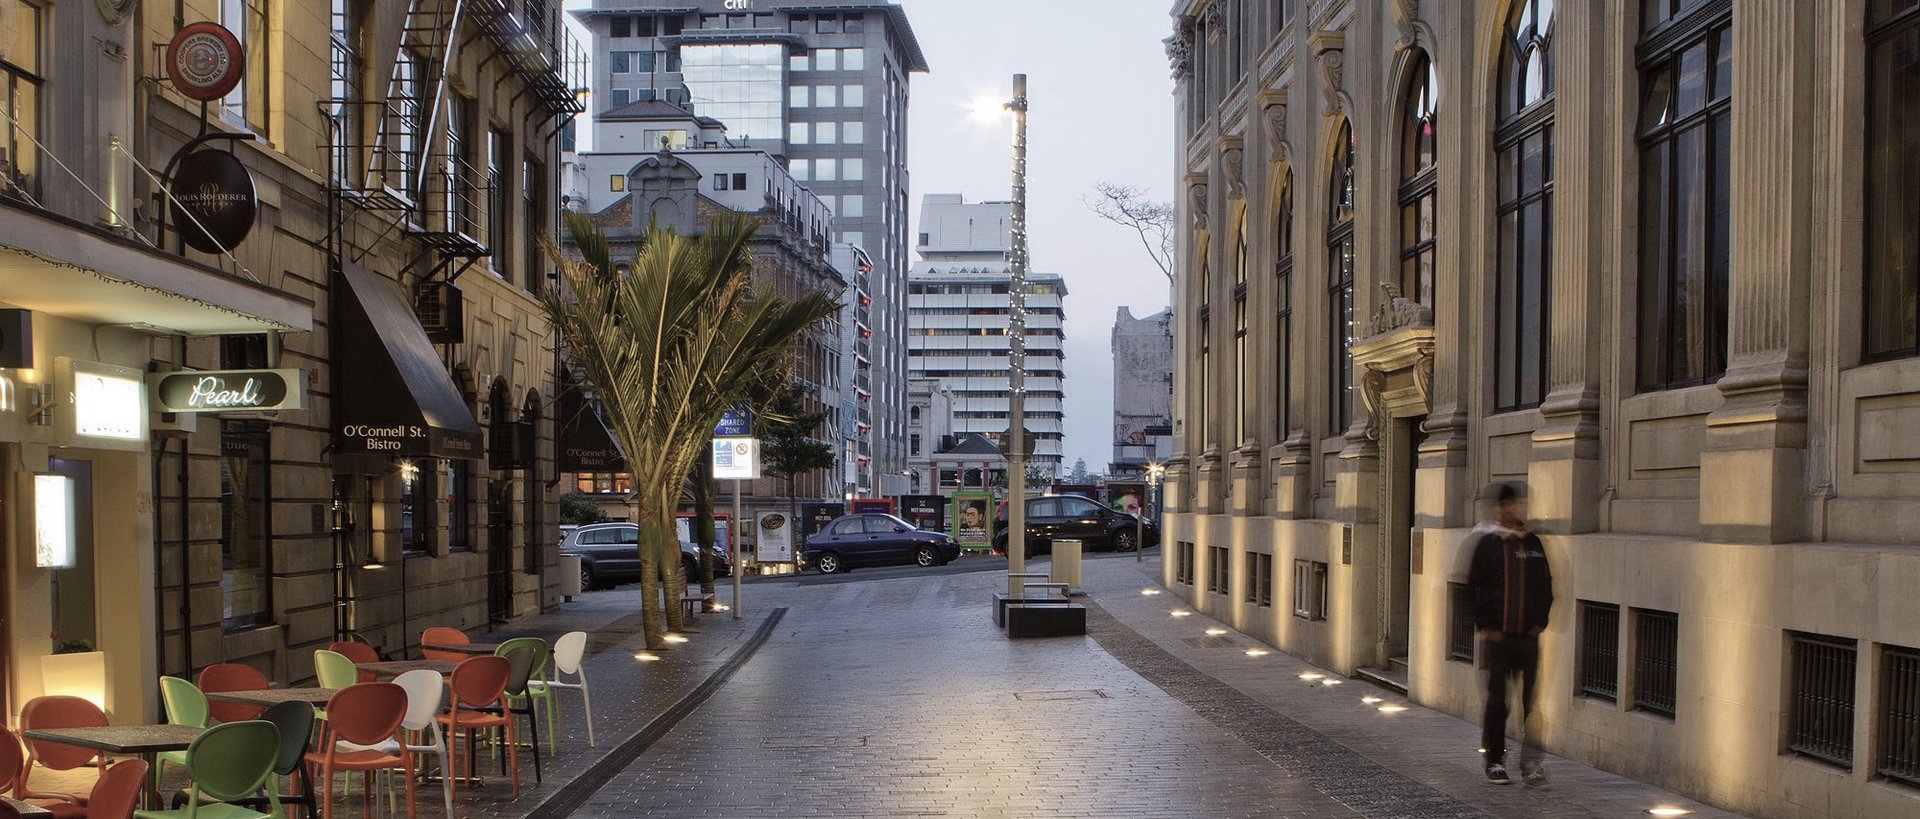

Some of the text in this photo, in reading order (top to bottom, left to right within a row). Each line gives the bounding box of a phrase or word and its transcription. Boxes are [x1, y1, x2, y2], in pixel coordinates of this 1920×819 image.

[179, 37, 196, 64] COOPERS
[197, 36, 223, 52] BREWERY
[175, 193, 247, 201] LOUIS ROEDERER
[189, 376, 261, 406] Pearl
[343, 425, 427, 438] O'Connell St.
[366, 438, 401, 450] Bistro
[581, 457, 604, 465] Bistro
